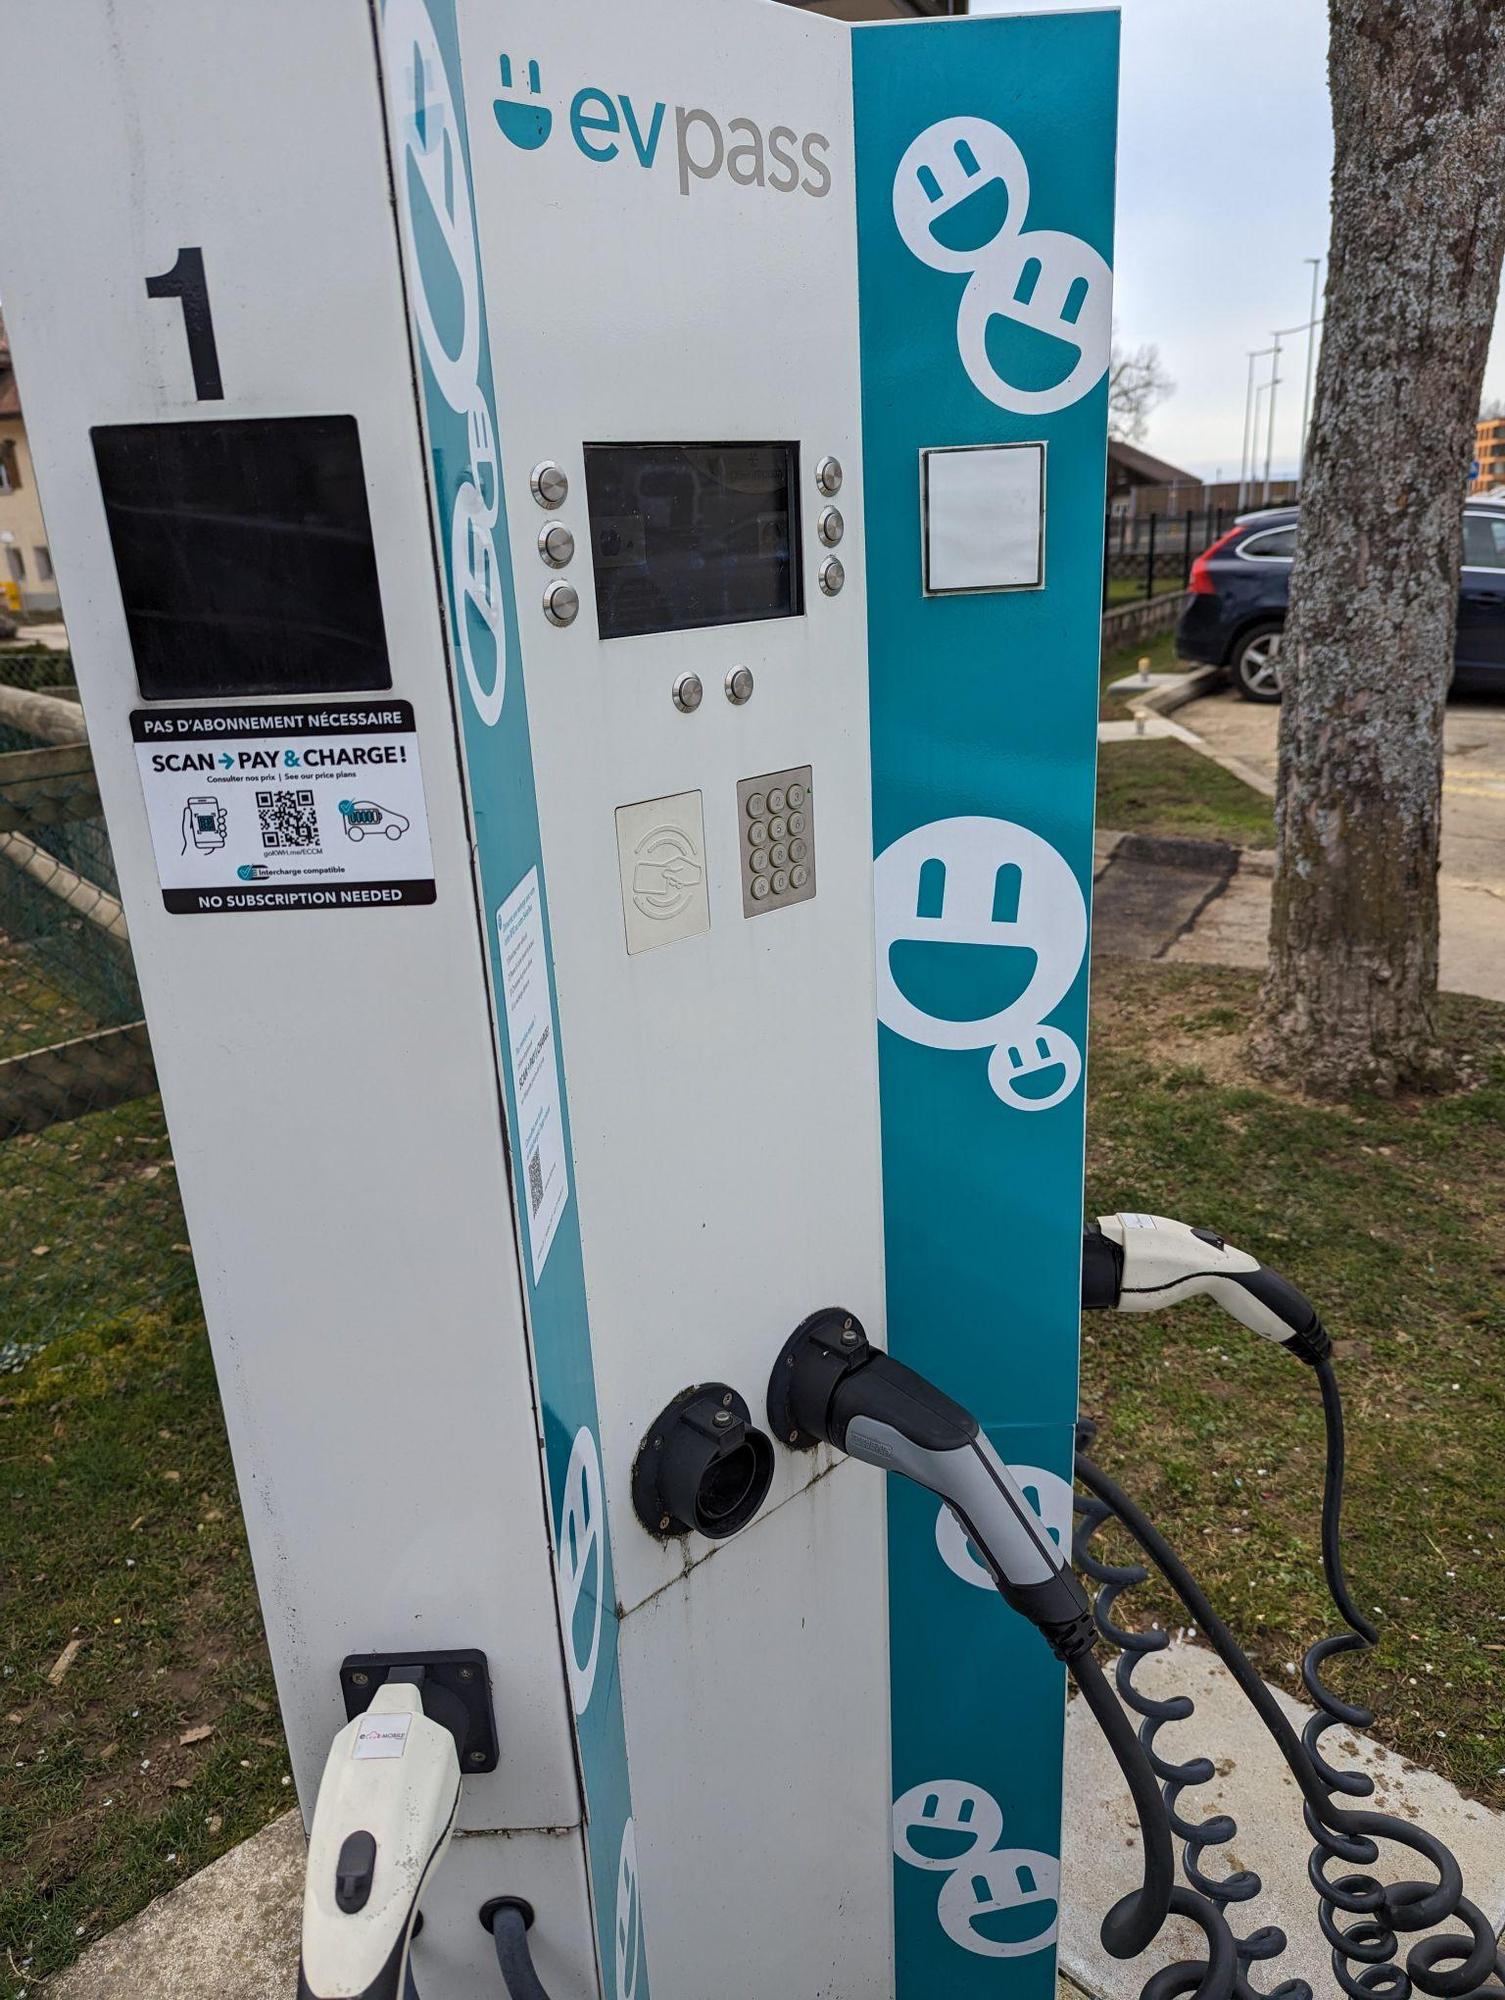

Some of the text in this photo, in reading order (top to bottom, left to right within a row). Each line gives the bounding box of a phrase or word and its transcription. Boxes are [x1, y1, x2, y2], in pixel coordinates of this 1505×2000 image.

[570, 87, 832, 198] evpass
[144, 246, 225, 401] 1
[144, 711, 402, 733] PAS D'ABONNEMENT NÉCESSAIRE
[152, 753, 215, 772] SCAN
[238, 751, 280, 769] PAY
[284, 750, 300, 768] &
[207, 774, 242, 783] Consulter
[260, 773, 275, 783] prix
[284, 771, 299, 780] See
[315, 771, 335, 780] price
[337, 770, 357, 780] plans
[303, 865, 345, 876] compatible
[199, 888, 402, 909] NO SUBSCRIPTION NEEDED
